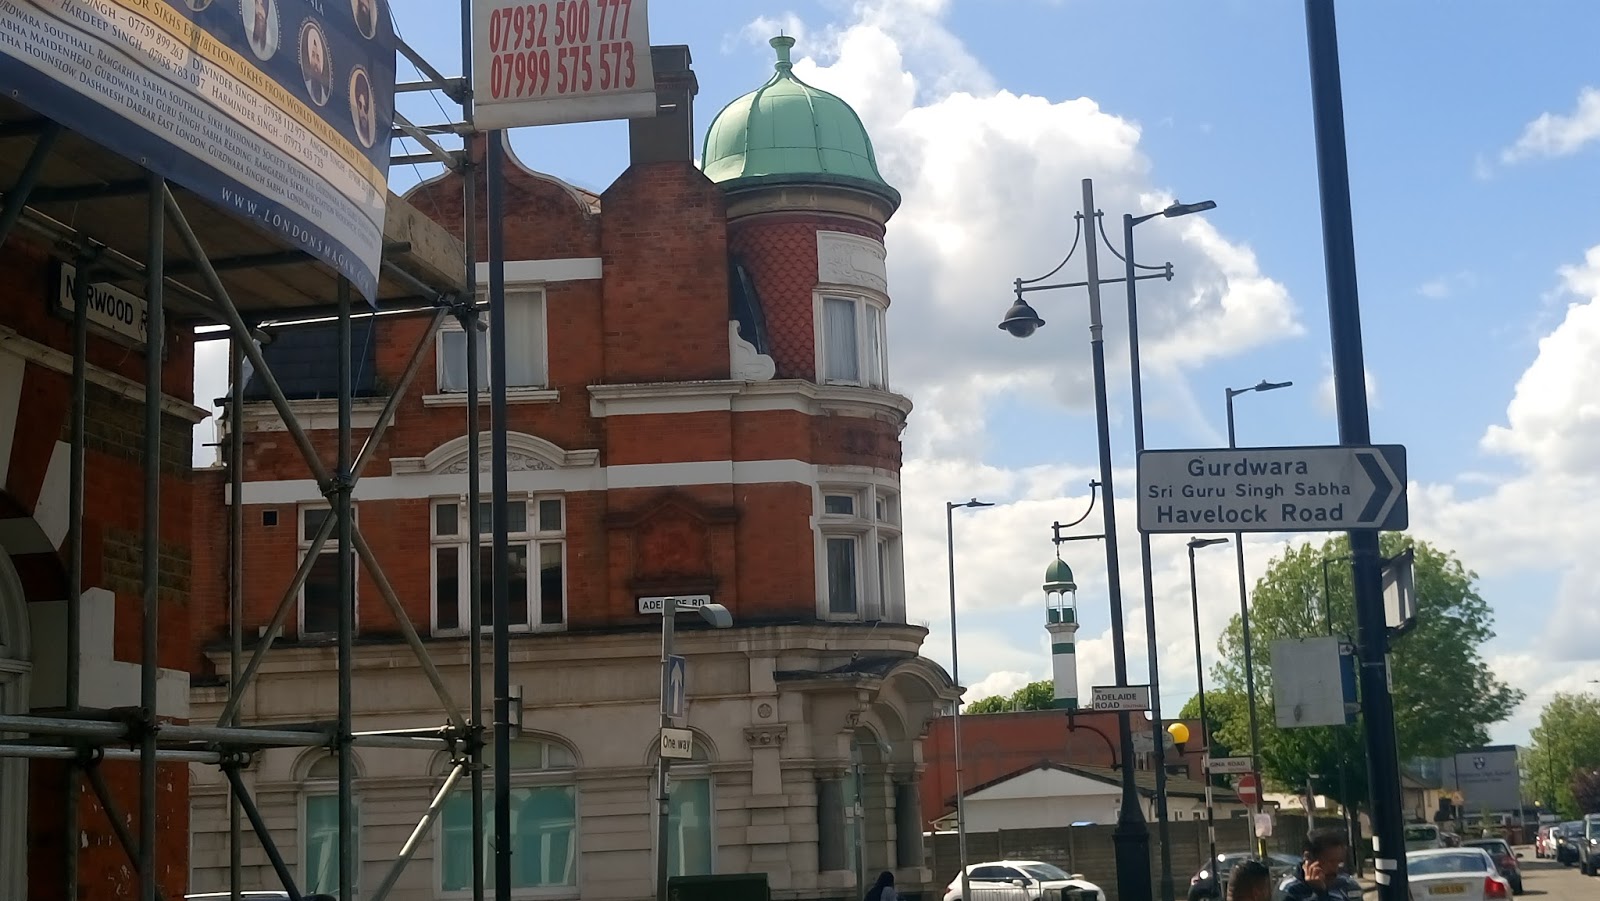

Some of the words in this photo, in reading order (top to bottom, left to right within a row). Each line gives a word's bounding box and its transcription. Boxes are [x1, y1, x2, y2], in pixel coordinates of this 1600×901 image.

[489, 3, 548, 53] 07932
[554, 0, 590, 46] 500
[597, 0, 632, 41] 777
[60, 0, 109, 32] HARDEEP
[112, 25, 142, 51] SINGH
[148, 47, 171, 71] 07958
[173, 62, 188, 81] 783
[190, 72, 206, 89] 037
[211, 85, 255, 123] HARMINDER
[257, 115, 278, 138] SINGH
[284, 133, 302, 153] 07973
[302, 145, 313, 160] 435
[128, 16, 155, 39] 07759
[156, 33, 171, 49] 899
[170, 43, 184, 60] 263
[192, 57, 234, 90] DAVINDER
[235, 84, 257, 107] SINGH
[263, 103, 282, 125] 07958
[284, 118, 294, 133] 112
[294, 123, 306, 141] 975
[154, 2, 181, 30] SIKHS
[184, 22, 236, 67] EXHIBITION
[236, 59, 263, 87] (SIKHS
[265, 80, 285, 103] FROM
[286, 93, 312, 124] WORLD
[490, 49, 550, 99] 07999
[557, 45, 593, 94] 575
[600, 41, 636, 91] 573
[95, 65, 140, 98] GURDWARA
[142, 91, 154, 105] SRI
[155, 98, 177, 118] GURU
[178, 111, 200, 132] SINGH
[202, 125, 222, 145] SABHA
[254, 156, 289, 186] RAMGARHIA
[289, 177, 304, 193] SIKH
[97, 48, 141, 84] RAMGARHIA
[143, 76, 167, 98] SABHA
[207, 114, 223, 131] SIKH
[224, 125, 261, 154] MISSIONARY
[262, 147, 285, 169] SOCIETY
[79, 71, 124, 105] DASHMESH
[126, 96, 156, 123] DARBAR
[157, 115, 175, 132] EAST
[208, 144, 244, 173] GURDWARA
[245, 165, 265, 186] SINGH
[266, 177, 285, 197] SABHA
[286, 189, 310, 211] LONDON
[311, 205, 323, 220] EAST
[66, 274, 134, 326] NRWOOD
[1148, 485, 1173, 499] Sri
[1182, 484, 1226, 498] Guru
[1236, 483, 1284, 499] Singh
[1294, 482, 1351, 497] Sabha
[1187, 457, 1309, 477] Gurdwara
[1157, 504, 1267, 524] Havelock
[1281, 503, 1343, 522] Road
[1095, 693, 1137, 701] ADELAIDE
[1095, 701, 1120, 709] ROAD
[662, 734, 676, 749] One
[677, 738, 690, 752] way
